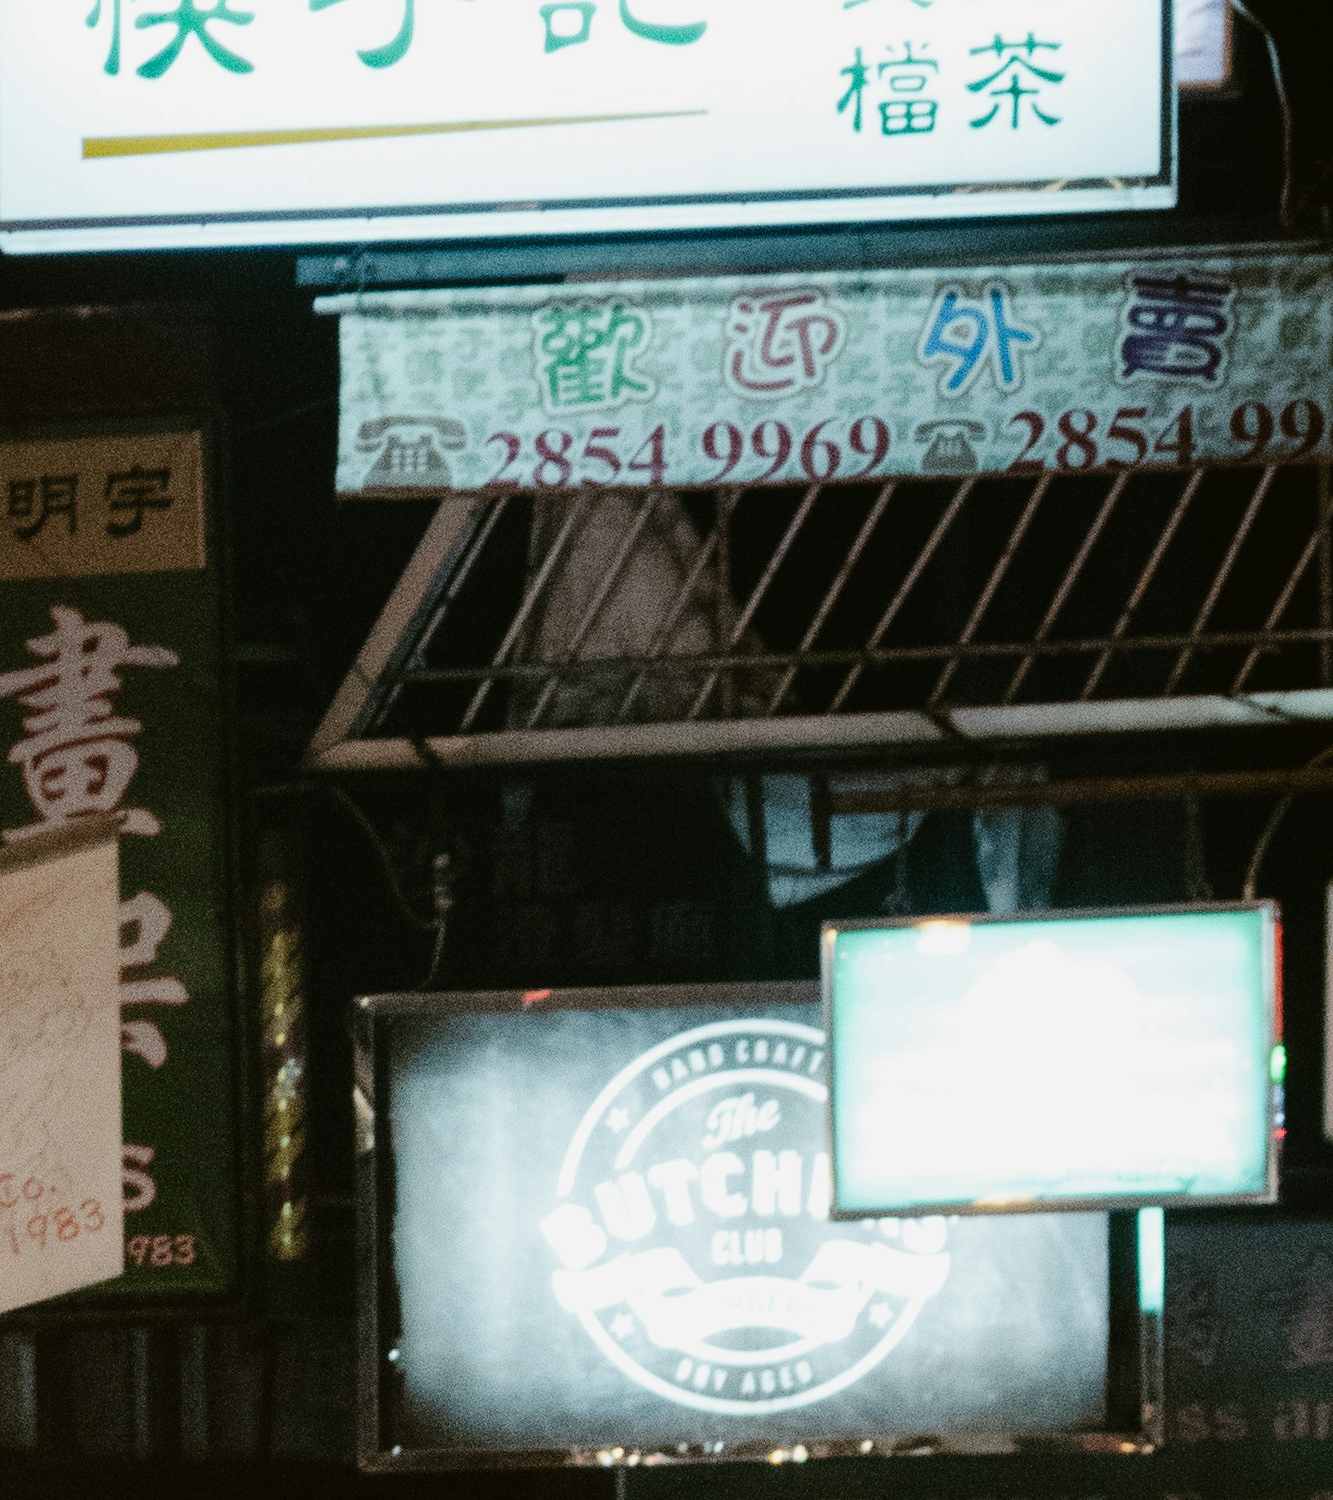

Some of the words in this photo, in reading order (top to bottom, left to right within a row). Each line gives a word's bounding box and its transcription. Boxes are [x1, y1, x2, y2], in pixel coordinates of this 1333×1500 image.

[483, 422, 671, 492] 2854
[701, 415, 893, 488] 9969
[1006, 405, 1199, 476] 2854
[702, 1091, 781, 1146] The
[3, 1201, 108, 1262] 1983
[711, 1226, 783, 1265] CLUB
